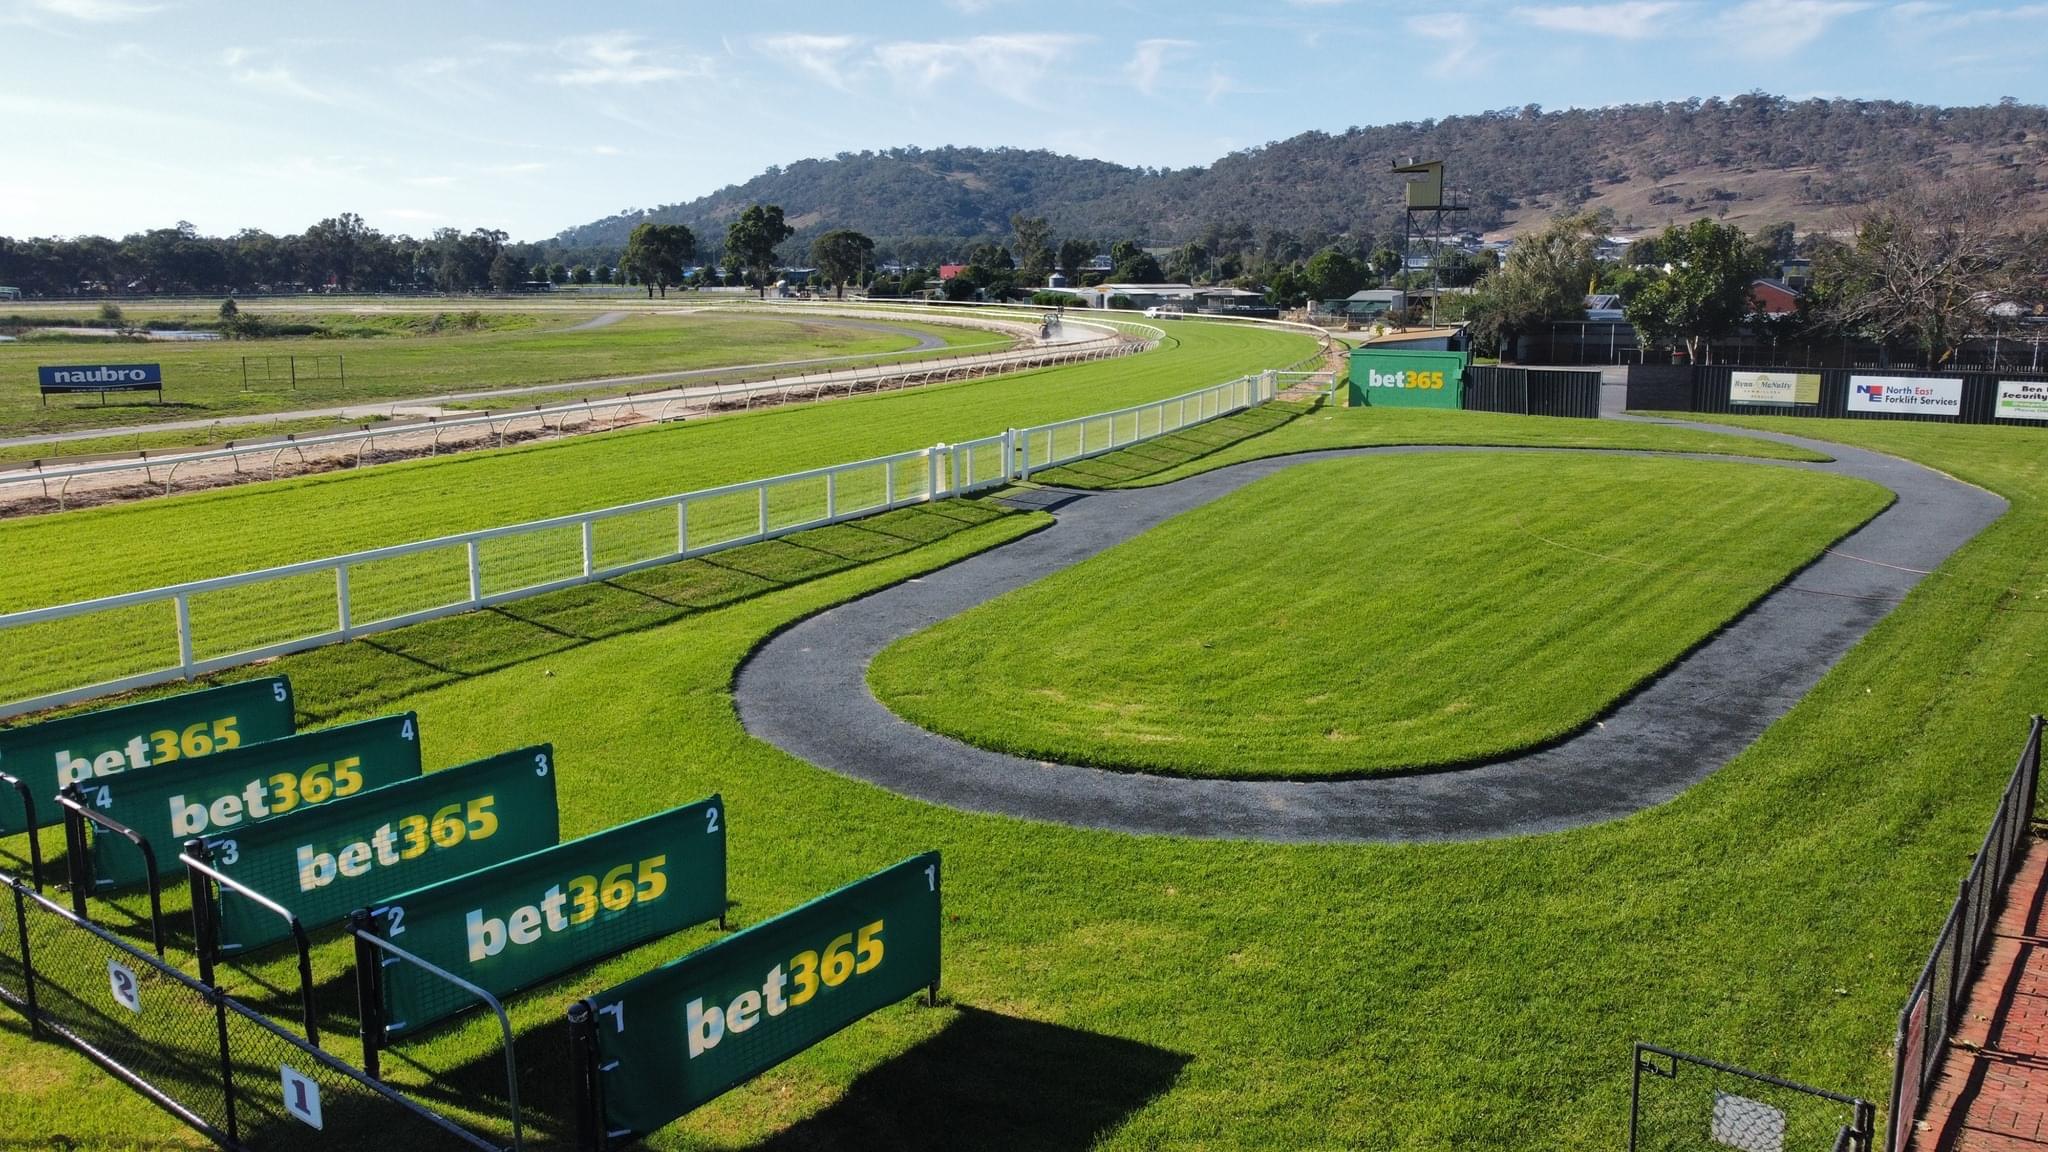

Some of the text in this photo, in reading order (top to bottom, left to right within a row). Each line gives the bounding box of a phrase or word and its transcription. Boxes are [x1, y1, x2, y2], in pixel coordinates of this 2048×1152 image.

[54, 366, 146, 383] naubro
[1369, 369, 1444, 389] bet365
[1885, 395, 1958, 406] Forklift Services
[1886, 386, 1933, 395] North East
[2003, 392, 2048, 402] Security
[272, 682, 287, 702] 5
[402, 719, 414, 741] 4
[55, 716, 240, 790] bet365
[535, 754, 548, 776] 3
[96, 785, 112, 809] 4
[169, 756, 363, 838] bet365
[706, 807, 719, 834] 2
[221, 839, 239, 865] 3
[297, 795, 499, 893] bet365
[924, 864, 936, 891] 1
[466, 854, 668, 962] bet365
[388, 906, 406, 938] 2
[114, 969, 134, 1003] 2
[686, 919, 884, 1060] bet365
[291, 1079, 312, 1116] 1
